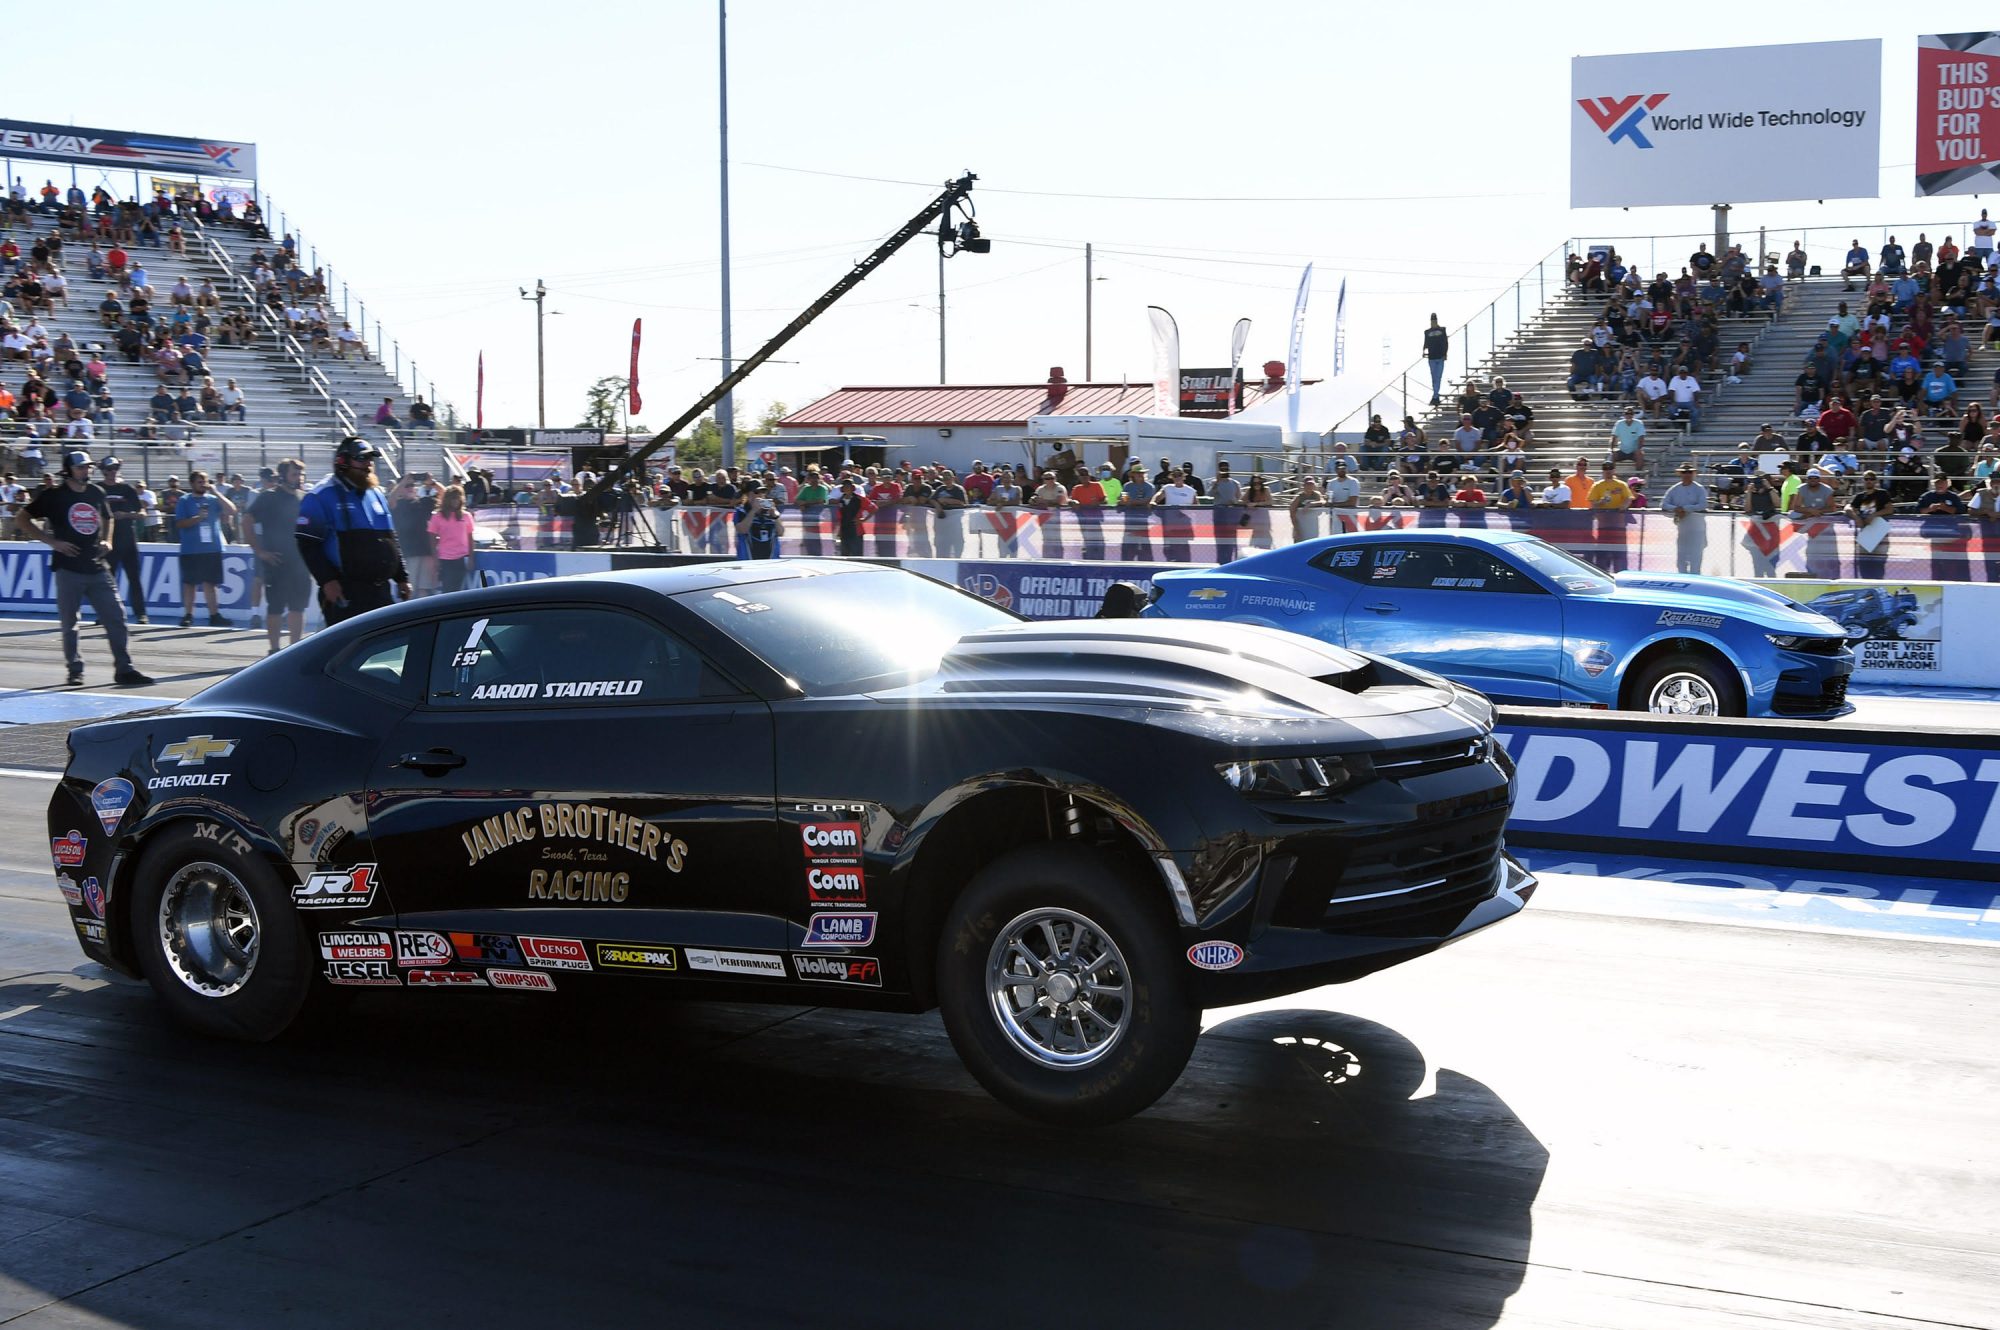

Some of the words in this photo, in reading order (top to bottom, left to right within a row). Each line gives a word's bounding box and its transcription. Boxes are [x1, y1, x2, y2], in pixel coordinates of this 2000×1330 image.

[1937, 62, 1988, 85] THIS
[1937, 86, 2000, 111] BUD'S
[1652, 114, 1703, 131] World
[1709, 112, 1754, 129] Wide
[1758, 108, 1866, 128] Technology
[1937, 113, 1980, 136] FOR
[0, 129, 103, 155] EWAY
[1936, 138, 1987, 161] YOU.
[1330, 551, 1363, 567] FSS
[1019, 576, 1083, 596] OFFICIAL
[1019, 598, 1072, 617] WORLD
[1242, 595, 1316, 611] PERFORMANCE
[464, 618, 490, 649] 1
[1864, 641, 1898, 650] COME
[1903, 642, 1935, 651] VISIT
[1860, 659, 1937, 670] SHOWROOM!
[1864, 650, 1889, 660] OUR
[1894, 651, 1935, 661] LARGE
[471, 683, 539, 700] AARON
[542, 680, 644, 698] STANFIELD
[147, 773, 231, 790] CHEVROLET
[462, 806, 536, 866] JANAC
[539, 803, 689, 873] BROTHER'S
[803, 825, 857, 847] Coan
[579, 848, 608, 862] Texas
[528, 868, 630, 902] RACING
[808, 868, 860, 890] Coan
[297, 897, 345, 905] RACING
[347, 896, 367, 904] OIL
[821, 918, 863, 933] LAMB
[322, 934, 379, 946] LINCOLN
[337, 948, 387, 958] WELDERS
[540, 944, 579, 956] DENSO
[613, 950, 672, 965] RACEPAK
[1196, 946, 1235, 964] NHRA
[323, 961, 398, 981] JESEL
[530, 958, 558, 967] SPARK
[561, 961, 590, 970] PLUGS
[720, 957, 783, 971] PERFORMANCE
[799, 957, 848, 981] Holley
[493, 971, 550, 988] SIMPSON
